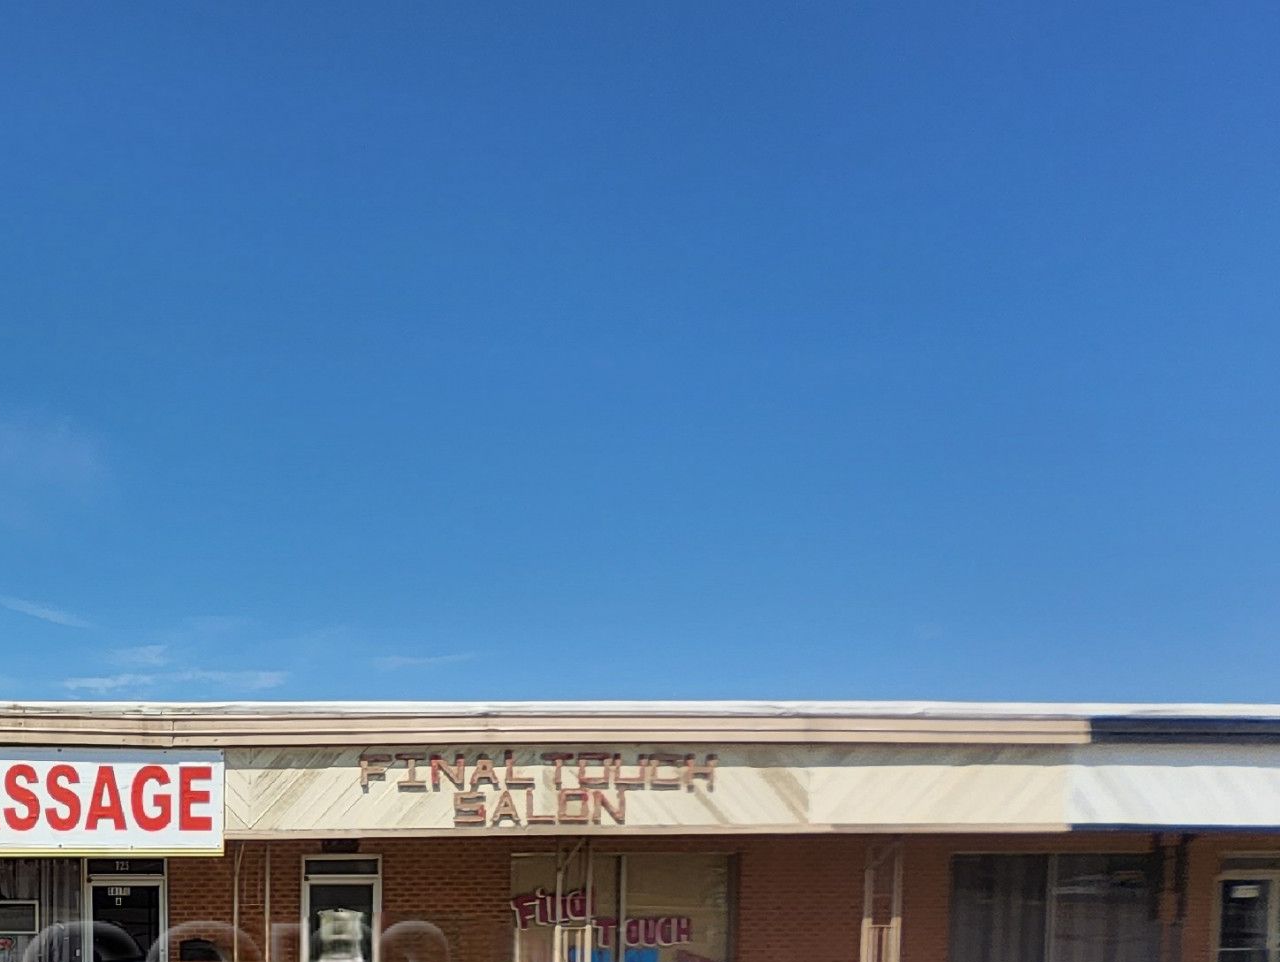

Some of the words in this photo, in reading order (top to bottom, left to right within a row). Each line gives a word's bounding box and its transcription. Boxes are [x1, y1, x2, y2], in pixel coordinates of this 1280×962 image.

[359, 750, 536, 793] FINAL
[540, 752, 720, 792] TOUCH
[452, 787, 626, 826] SALON
